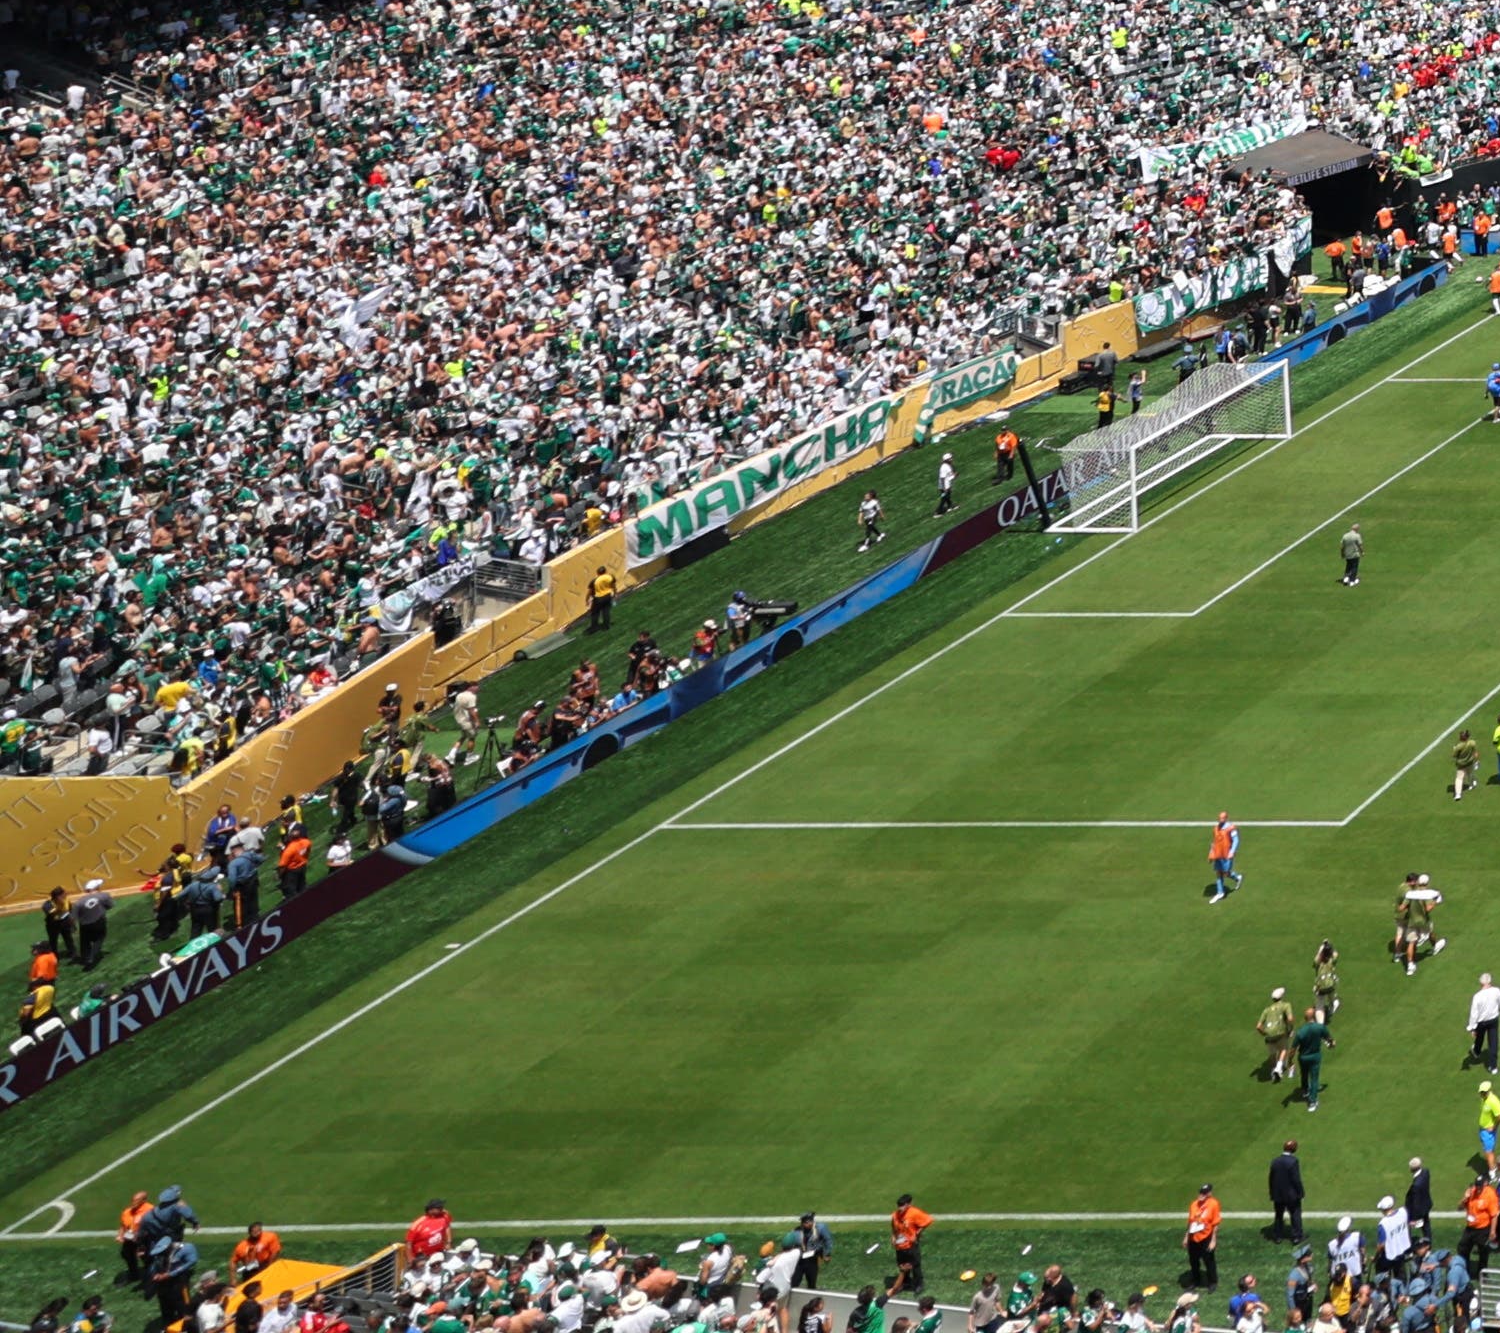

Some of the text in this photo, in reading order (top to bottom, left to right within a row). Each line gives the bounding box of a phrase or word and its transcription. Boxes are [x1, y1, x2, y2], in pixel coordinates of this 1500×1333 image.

[1287, 158, 1359, 186] METLIFE STADIUM
[635, 399, 893, 558] MANCHA
[45, 909, 283, 1081] AIRWAYS
